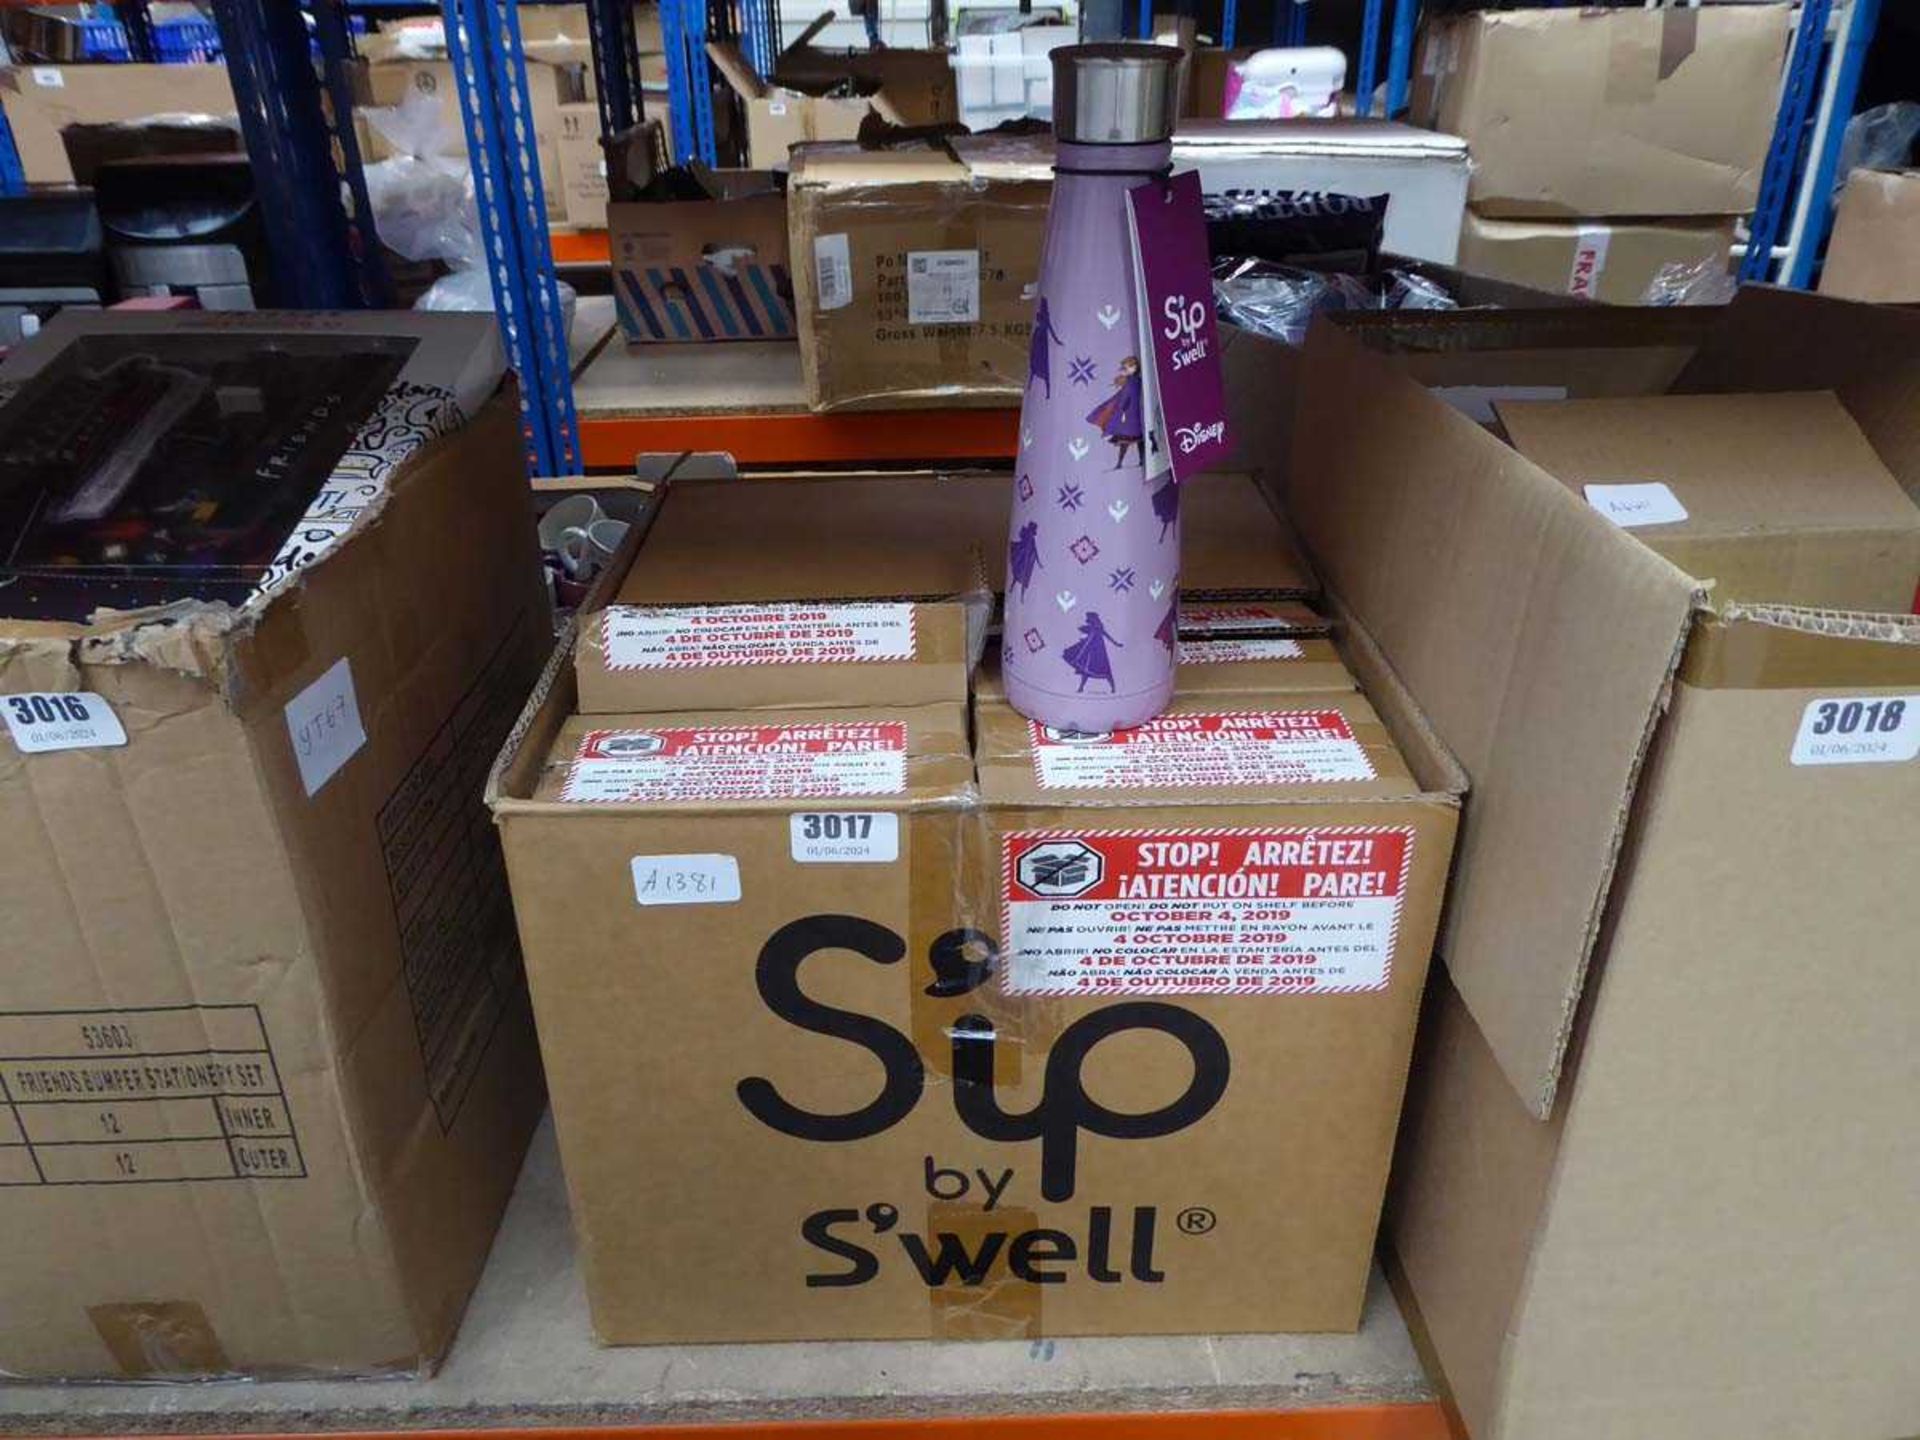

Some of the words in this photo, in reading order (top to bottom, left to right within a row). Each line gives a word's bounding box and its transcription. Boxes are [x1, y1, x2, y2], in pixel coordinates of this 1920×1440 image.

[691, 616, 702, 625] 4
[704, 613, 785, 624] OCTOBRE
[789, 612, 826, 620] 2019
[665, 636, 676, 644] 4
[680, 635, 702, 643] DE
[707, 631, 785, 642] OCTUBRE
[790, 630, 811, 638] DE
[816, 629, 853, 637] 2019
[666, 653, 676, 661] 4
[681, 652, 702, 660] DE
[707, 649, 787, 659] OUTUBRO
[792, 648, 814, 656] DE
[818, 646, 855, 655] 2019
[8, 695, 90, 725] 3016
[1813, 700, 1906, 735] 3018
[1221, 715, 1320, 729] ARRÊTEZ!
[693, 731, 759, 743] STOP!
[777, 725, 880, 741] ARRÊTEZ!
[1274, 728, 1339, 740] PARE!
[827, 739, 894, 752] PARE!
[803, 814, 873, 839] 3017
[1138, 842, 1220, 867] STOP!
[1243, 833, 1373, 866] ARRÊTEZ!
[641, 869, 716, 894] A1381
[1119, 867, 1279, 898] ¡ATENCIÓN!
[1303, 872, 1386, 897] PARE!
[1110, 911, 1212, 922] OCTOBER
[1217, 910, 1236, 922] 4,
[1243, 910, 1291, 921] 2019
[1185, 924, 1236, 932] METTRE
[1312, 923, 1355, 931] AVANT
[1113, 934, 1127, 944] 4
[1133, 933, 1234, 944] OCTOBRE
[1239, 933, 1287, 943] 2019
[1080, 956, 1092, 966] 4
[1098, 956, 1126, 966] DE
[1132, 955, 1231, 965] OCTUBRE
[1237, 954, 1265, 964] DE
[1269, 954, 1317, 964] 2019
[1048, 968, 1076, 976] NÃO
[1123, 968, 1152, 976] NÃO
[1077, 977, 1091, 986] 4
[1096, 977, 1124, 986] DE
[1132, 976, 1230, 986] OUTUBRO
[1237, 976, 1264, 985] DE
[1269, 976, 1317, 985] 2019
[81, 1025, 133, 1049] 53603
[100, 1113, 121, 1134] 12
[226, 1107, 275, 1129] INNER
[116, 1153, 137, 1175] 12
[238, 1147, 290, 1169] OUTER
[924, 1155, 1015, 1212] by
[801, 1202, 1165, 1288] S'well
